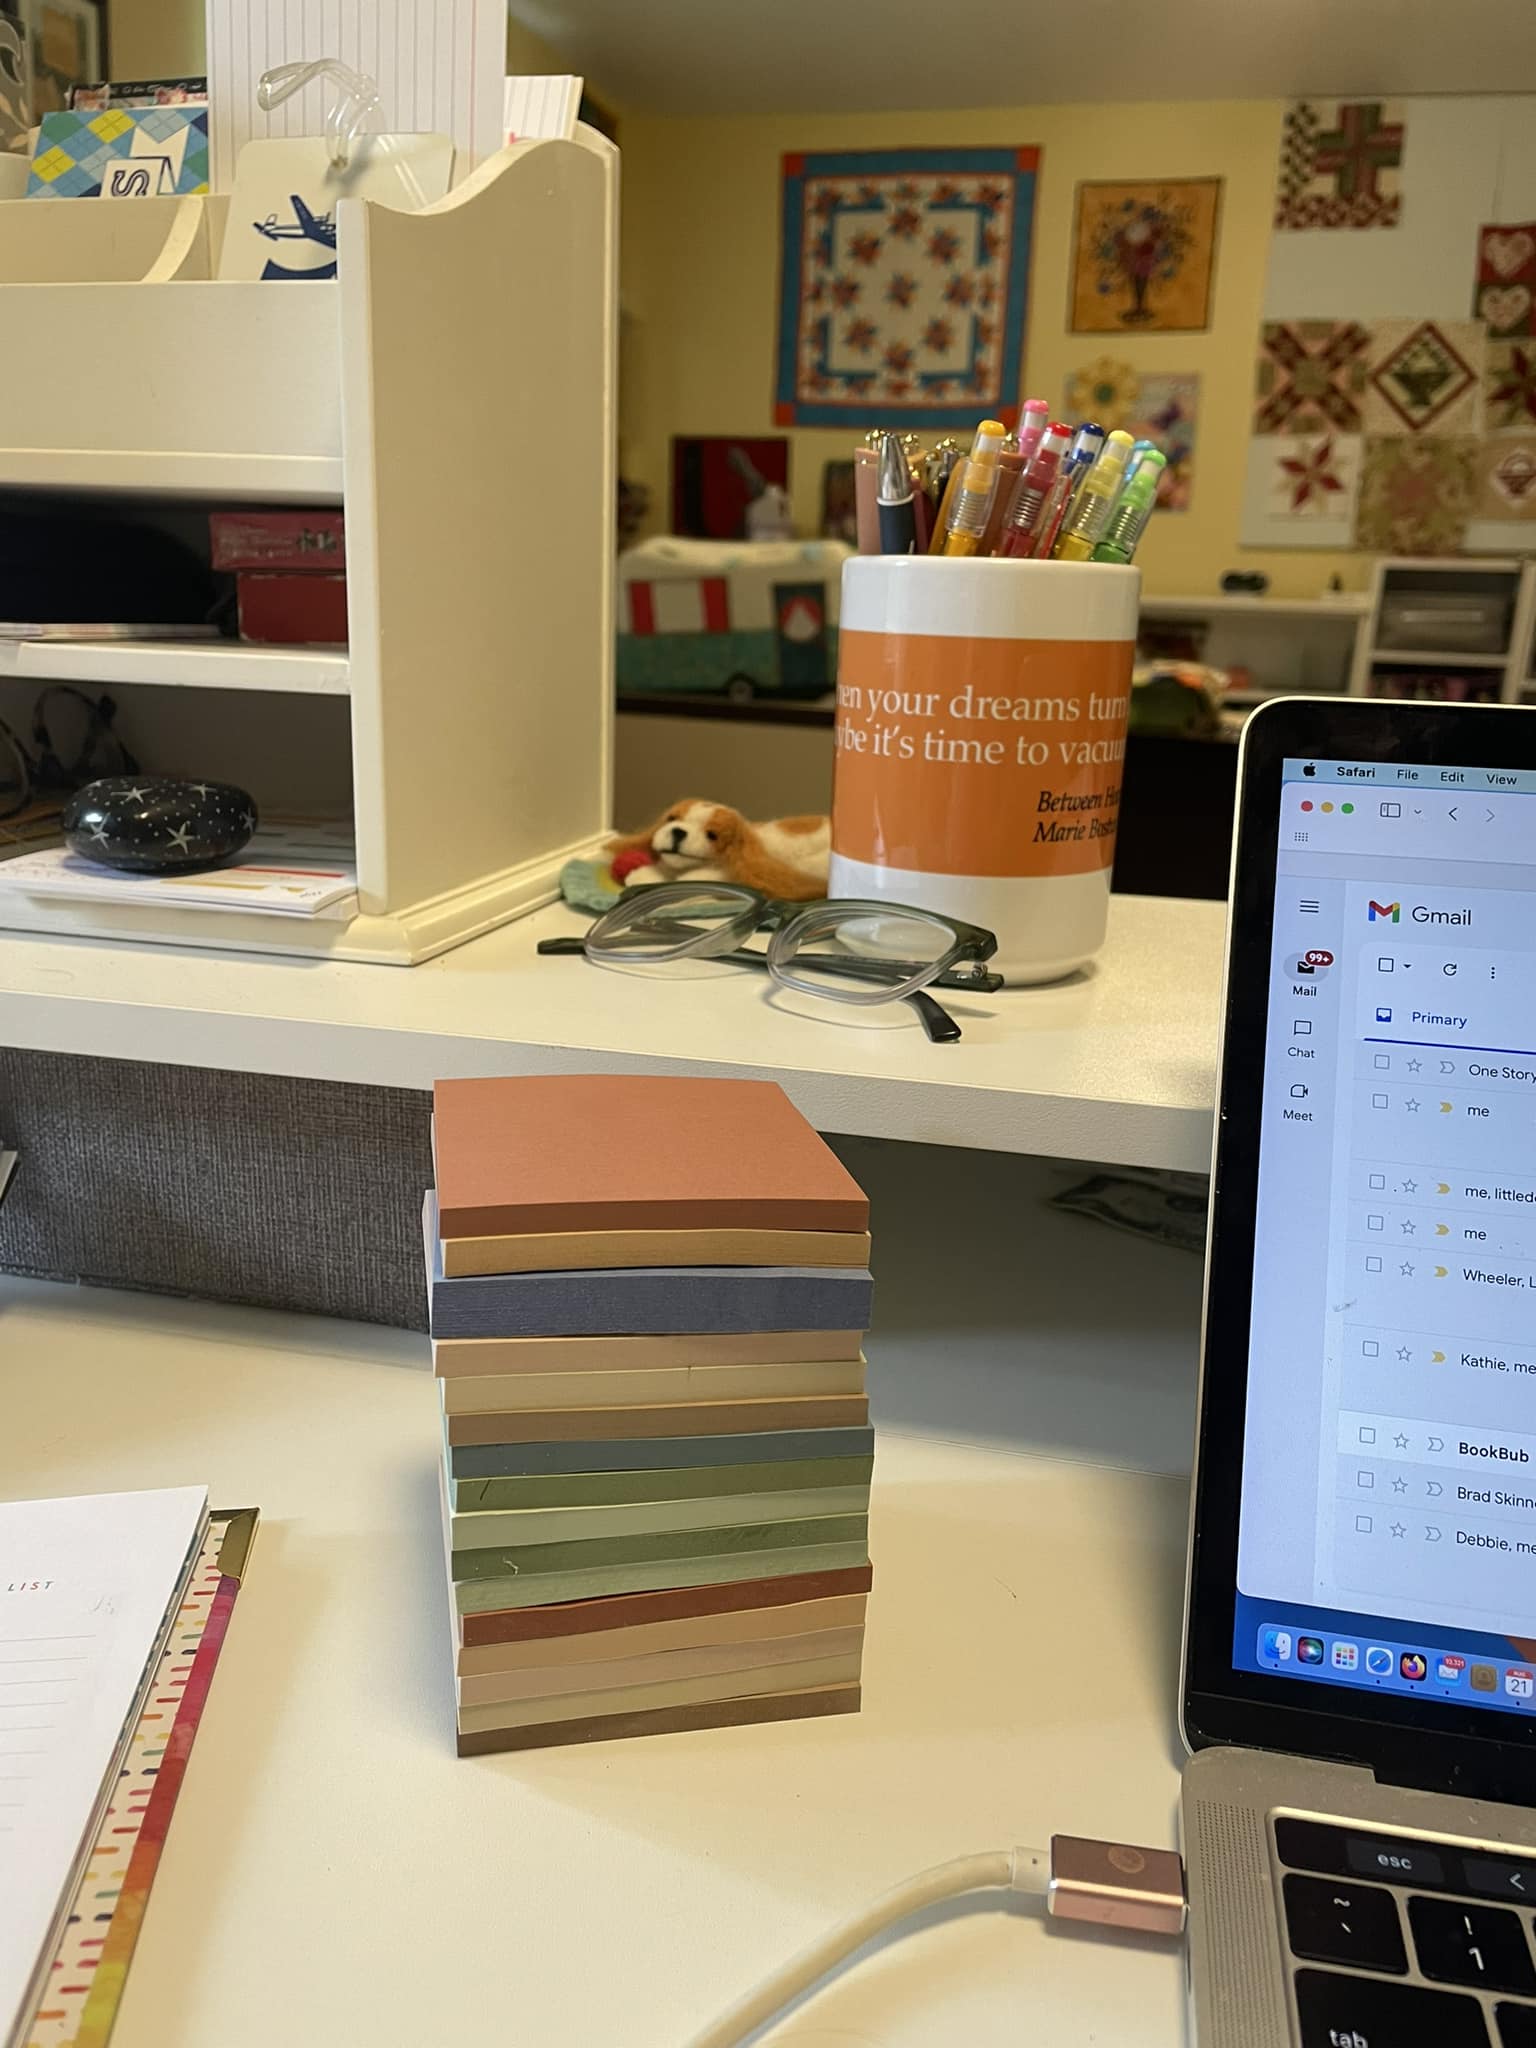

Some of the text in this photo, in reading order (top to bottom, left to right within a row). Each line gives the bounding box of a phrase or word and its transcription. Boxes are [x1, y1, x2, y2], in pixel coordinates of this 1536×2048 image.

[866, 688, 940, 722] your
[949, 684, 1081, 721] dreams
[923, 729, 1004, 765] time
[1016, 736, 1049, 766] to
[1337, 766, 1518, 785] Safari File Edit View
[1036, 790, 1103, 814] Between
[1032, 820, 1086, 843] Marie
[1412, 906, 1472, 926] Gmail
[1308, 953, 1330, 963] 99+
[1292, 985, 1317, 997] Mail
[1412, 1011, 1468, 1029] Primary
[1287, 1047, 1315, 1058] Chat
[1468, 1064, 1498, 1078] One
[1283, 1109, 1313, 1121] Meet
[1467, 1106, 1490, 1117] me
[1465, 1187, 1536, 1203] me, littled
[1464, 1229, 1487, 1240] me
[1463, 1268, 1525, 1288] Wheeler,
[1461, 1353, 1509, 1372] Kathie,
[1459, 1442, 1529, 1463] BookBub
[1457, 1486, 1536, 1509] Brad Skinn
[1456, 1531, 1512, 1552] Debbie,
[7, 1580, 54, 1592] LIST
[1511, 1679, 1527, 1694] 21
[1377, 1853, 1412, 1870] esc
[1468, 1947, 1485, 1970] 1
[1329, 2028, 1369, 2048] tab
